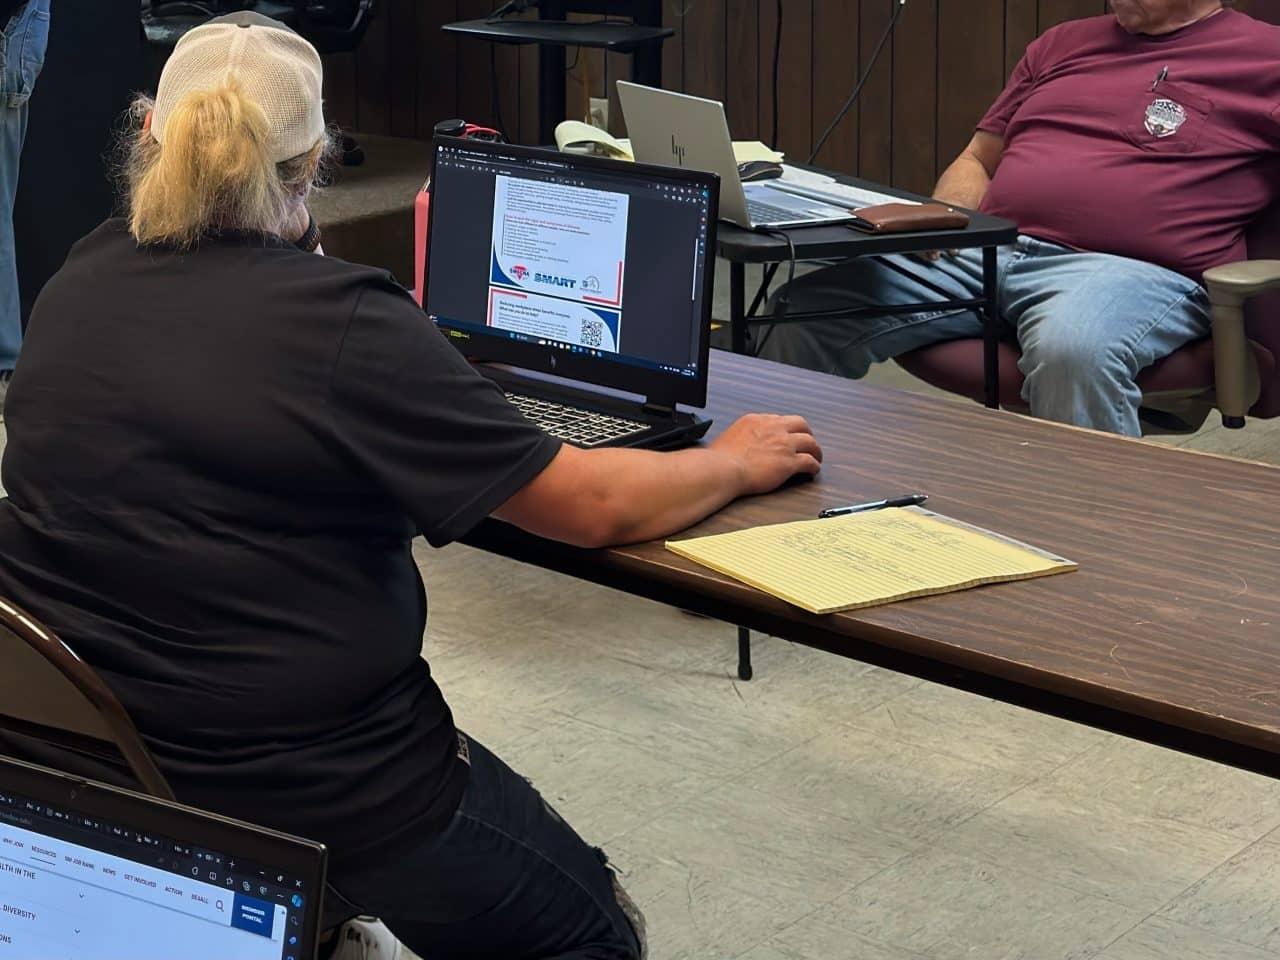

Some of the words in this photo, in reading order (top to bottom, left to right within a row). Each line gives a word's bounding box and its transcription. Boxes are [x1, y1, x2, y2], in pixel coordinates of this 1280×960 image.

[534, 272, 577, 289] SMART
[14, 866, 22, 875] IN
[23, 869, 37, 880] THE
[2, 903, 37, 922] DIVERSITY
